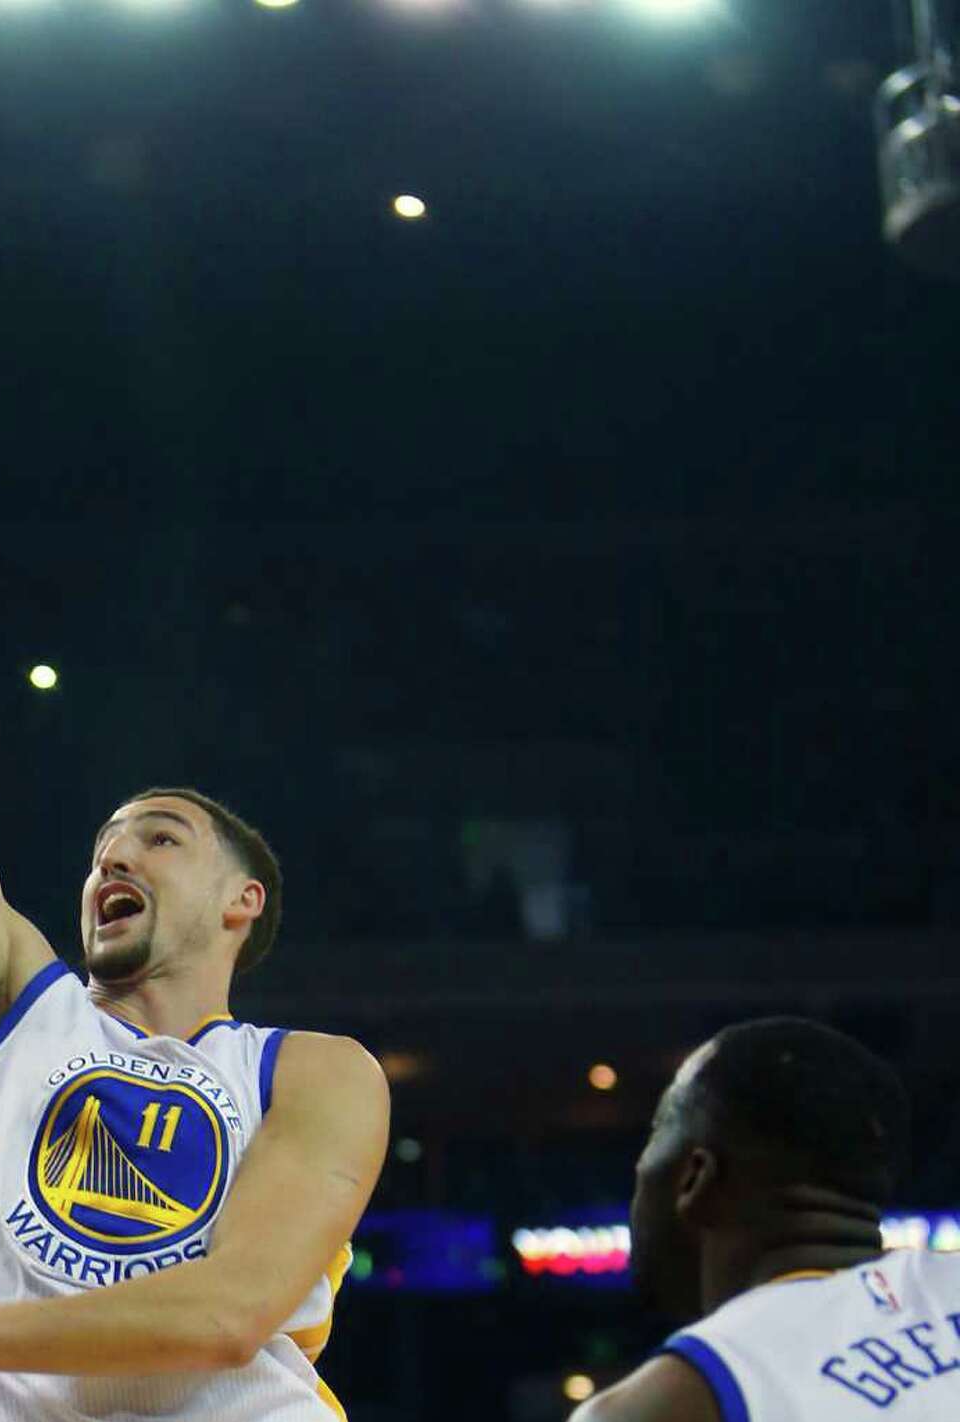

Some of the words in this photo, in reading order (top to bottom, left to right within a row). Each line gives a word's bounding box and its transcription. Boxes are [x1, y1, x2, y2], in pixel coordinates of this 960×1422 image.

[48, 1051, 170, 1087] GOLDEN
[177, 1068, 241, 1131] STATE
[136, 1102, 182, 1152] 11
